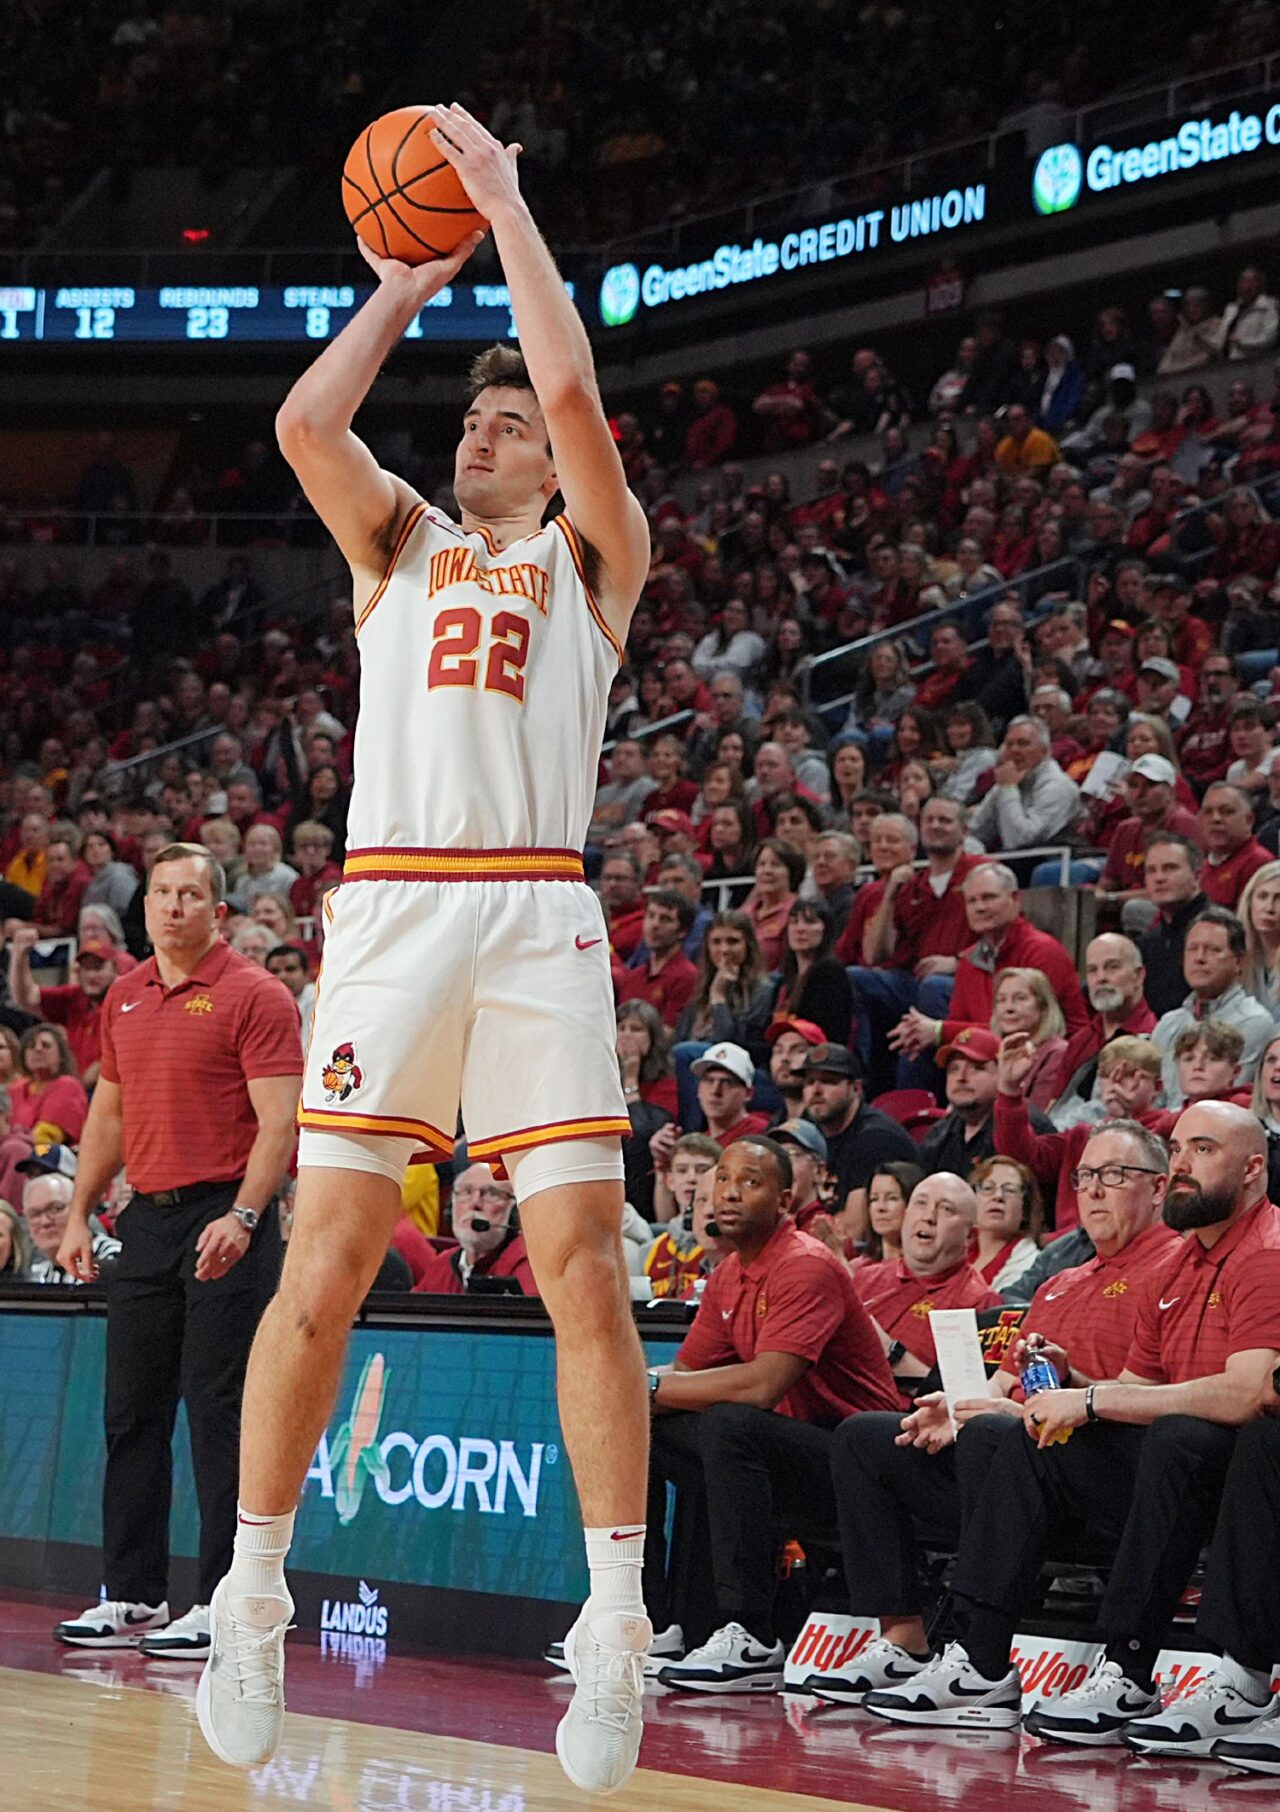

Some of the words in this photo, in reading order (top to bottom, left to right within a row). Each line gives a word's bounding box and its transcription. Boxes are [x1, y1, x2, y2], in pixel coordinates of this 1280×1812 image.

[1087, 110, 1262, 191] GreenState
[642, 238, 779, 307] GreenState
[780, 210, 884, 271] CREDIT
[890, 184, 985, 242] UNION
[0, 310, 20, 339] 1
[75, 308, 115, 339] 12
[186, 308, 229, 339] 23
[160, 287, 258, 308] REBOUNDS
[284, 287, 354, 307] STEALS
[428, 547, 478, 601] IOWA
[475, 563, 549, 619] STATE
[427, 606, 531, 705] 22
[320, 1599, 388, 1636] LANDUS
